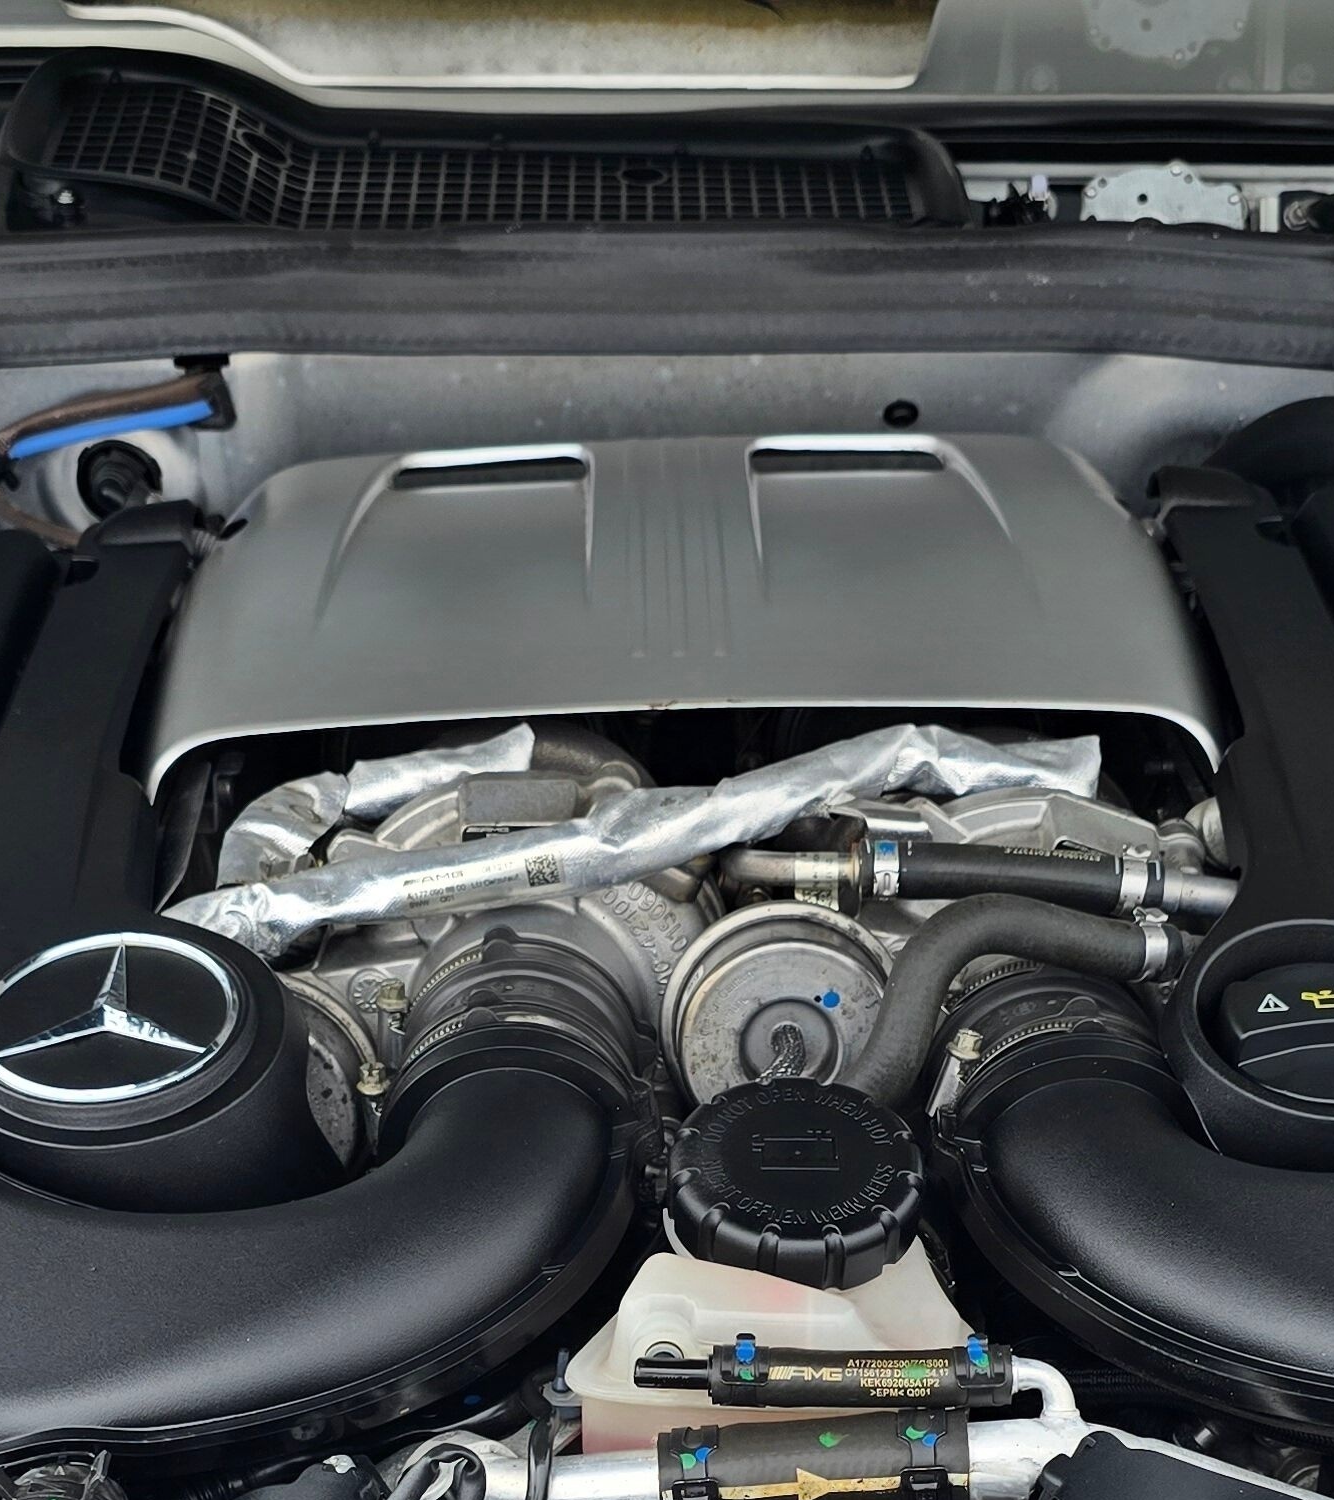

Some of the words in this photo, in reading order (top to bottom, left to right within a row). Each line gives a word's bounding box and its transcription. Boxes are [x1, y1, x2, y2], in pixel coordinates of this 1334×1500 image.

[701, 1123, 724, 1143] DO
[723, 1097, 754, 1125] NOT
[756, 1088, 806, 1106] OPEN
[814, 1092, 869, 1122] WHEN
[861, 1116, 894, 1147] HOT
[809, 1197, 866, 1225] WENN
[861, 1162, 896, 1206] HEISS
[785, 1366, 843, 1382] AMG
[845, 1368, 892, 1378] CT156129
[869, 1388, 905, 1397] >EPM<
[906, 1388, 931, 1397] Q001
